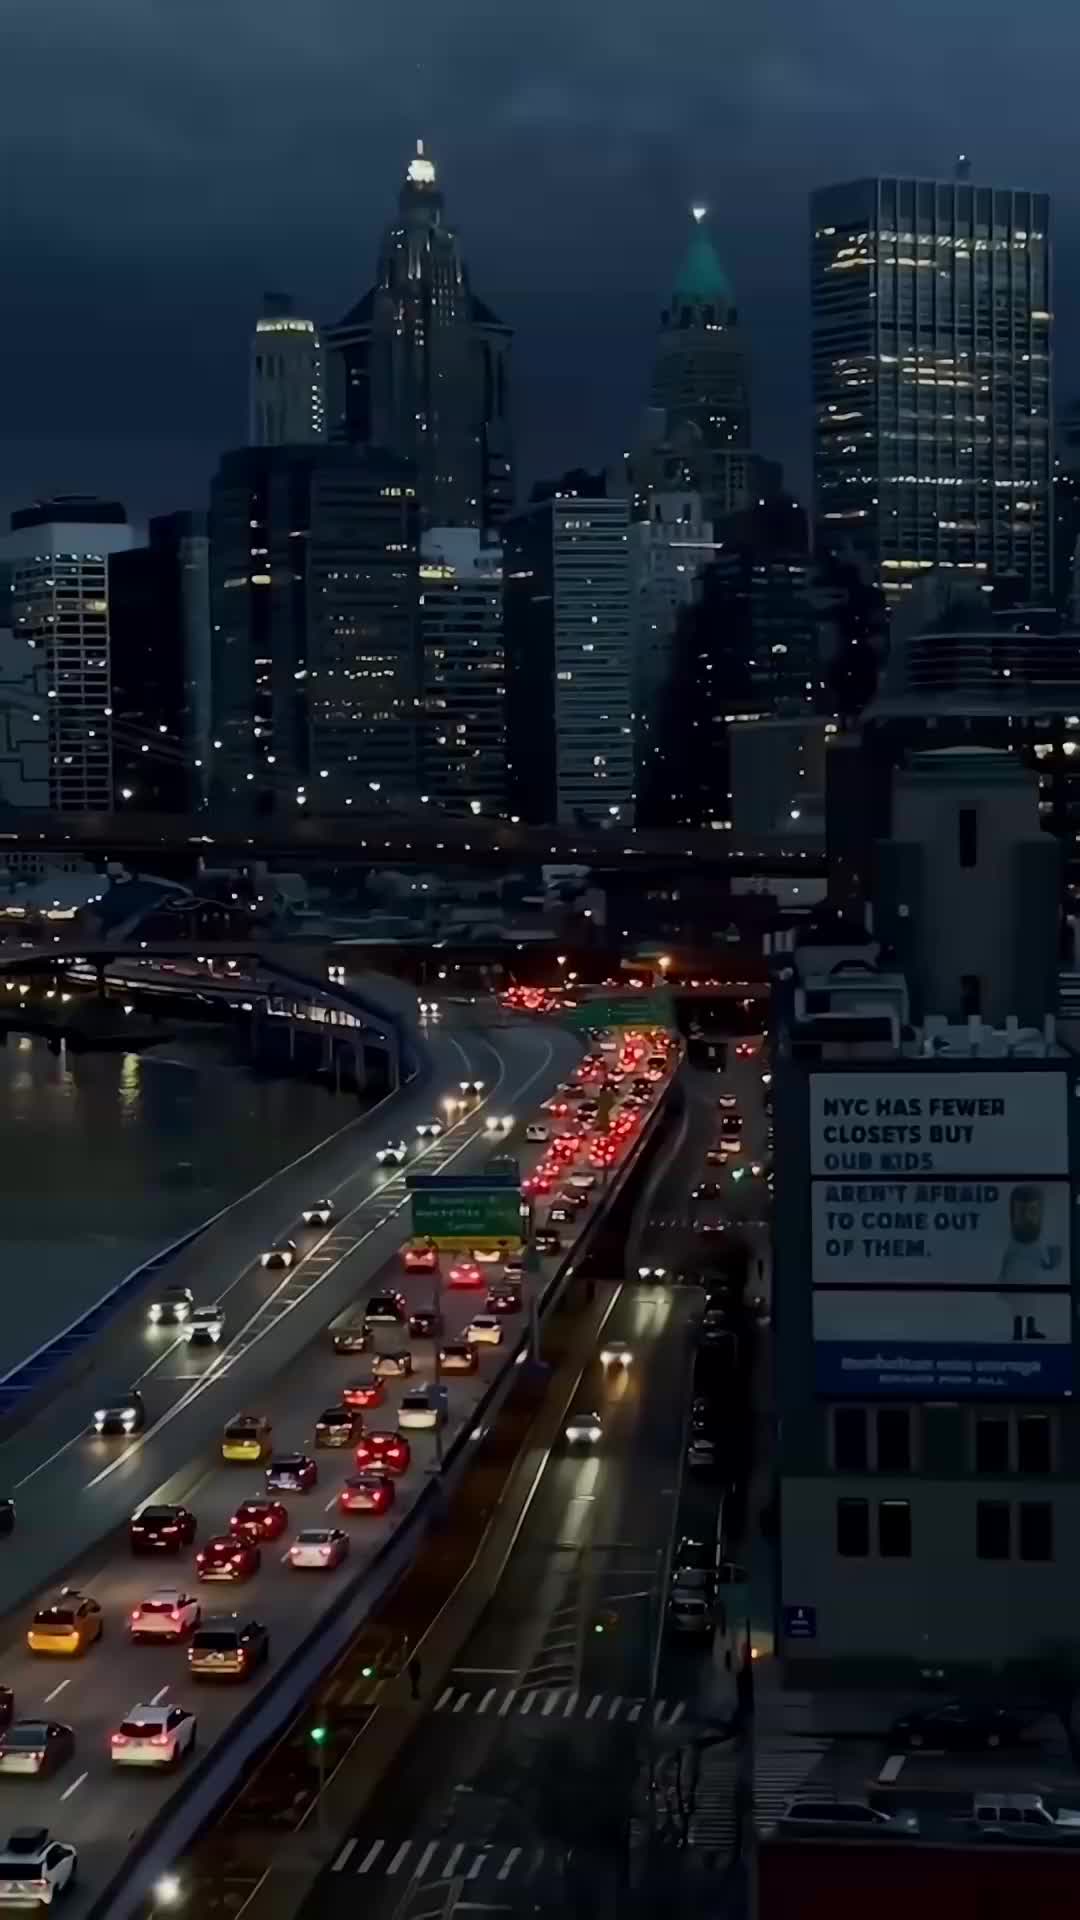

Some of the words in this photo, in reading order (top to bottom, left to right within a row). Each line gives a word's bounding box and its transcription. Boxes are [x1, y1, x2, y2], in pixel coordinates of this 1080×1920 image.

[824, 1098, 869, 1116] NYC
[876, 1098, 922, 1116] HAS
[929, 1098, 1005, 1117] FEWER
[824, 1125, 922, 1144] CLOSETS
[929, 1125, 974, 1144] BUT
[880, 1152, 934, 1170] KIDS
[825, 1185, 907, 1203] AREN'T
[915, 1185, 999, 1203] AFRAID
[825, 1212, 854, 1230] TO
[862, 1212, 928, 1230] COME
[934, 1212, 980, 1230] OUT
[826, 1239, 853, 1257] OF
[863, 1239, 932, 1257] THEM.
